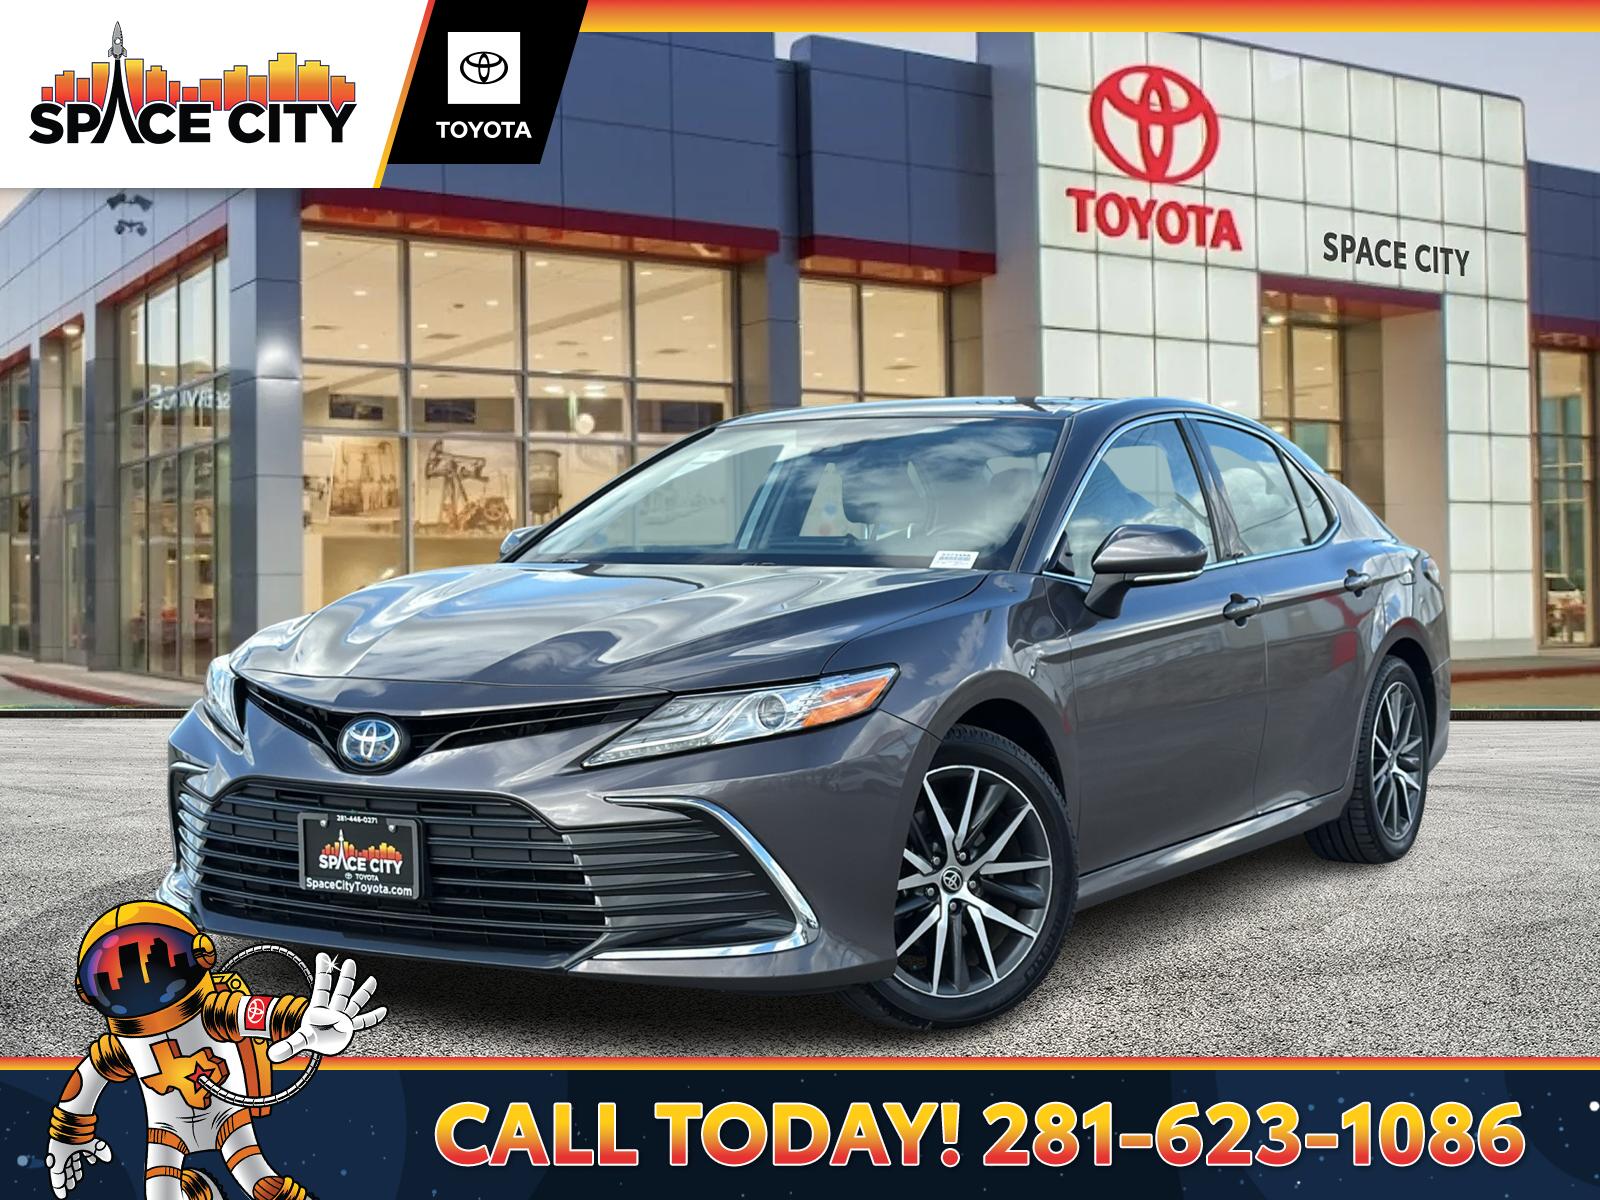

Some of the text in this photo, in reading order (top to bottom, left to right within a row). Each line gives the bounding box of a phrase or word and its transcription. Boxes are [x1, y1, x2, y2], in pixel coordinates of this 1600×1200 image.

[1066, 188, 1243, 252] TOYOTA
[1322, 231, 1470, 277] SPACE CITY
[318, 853, 403, 875] SPACE CITY
[306, 877, 413, 896] SpaceCityToyota.com
[355, 873, 379, 881] TOYOTA
